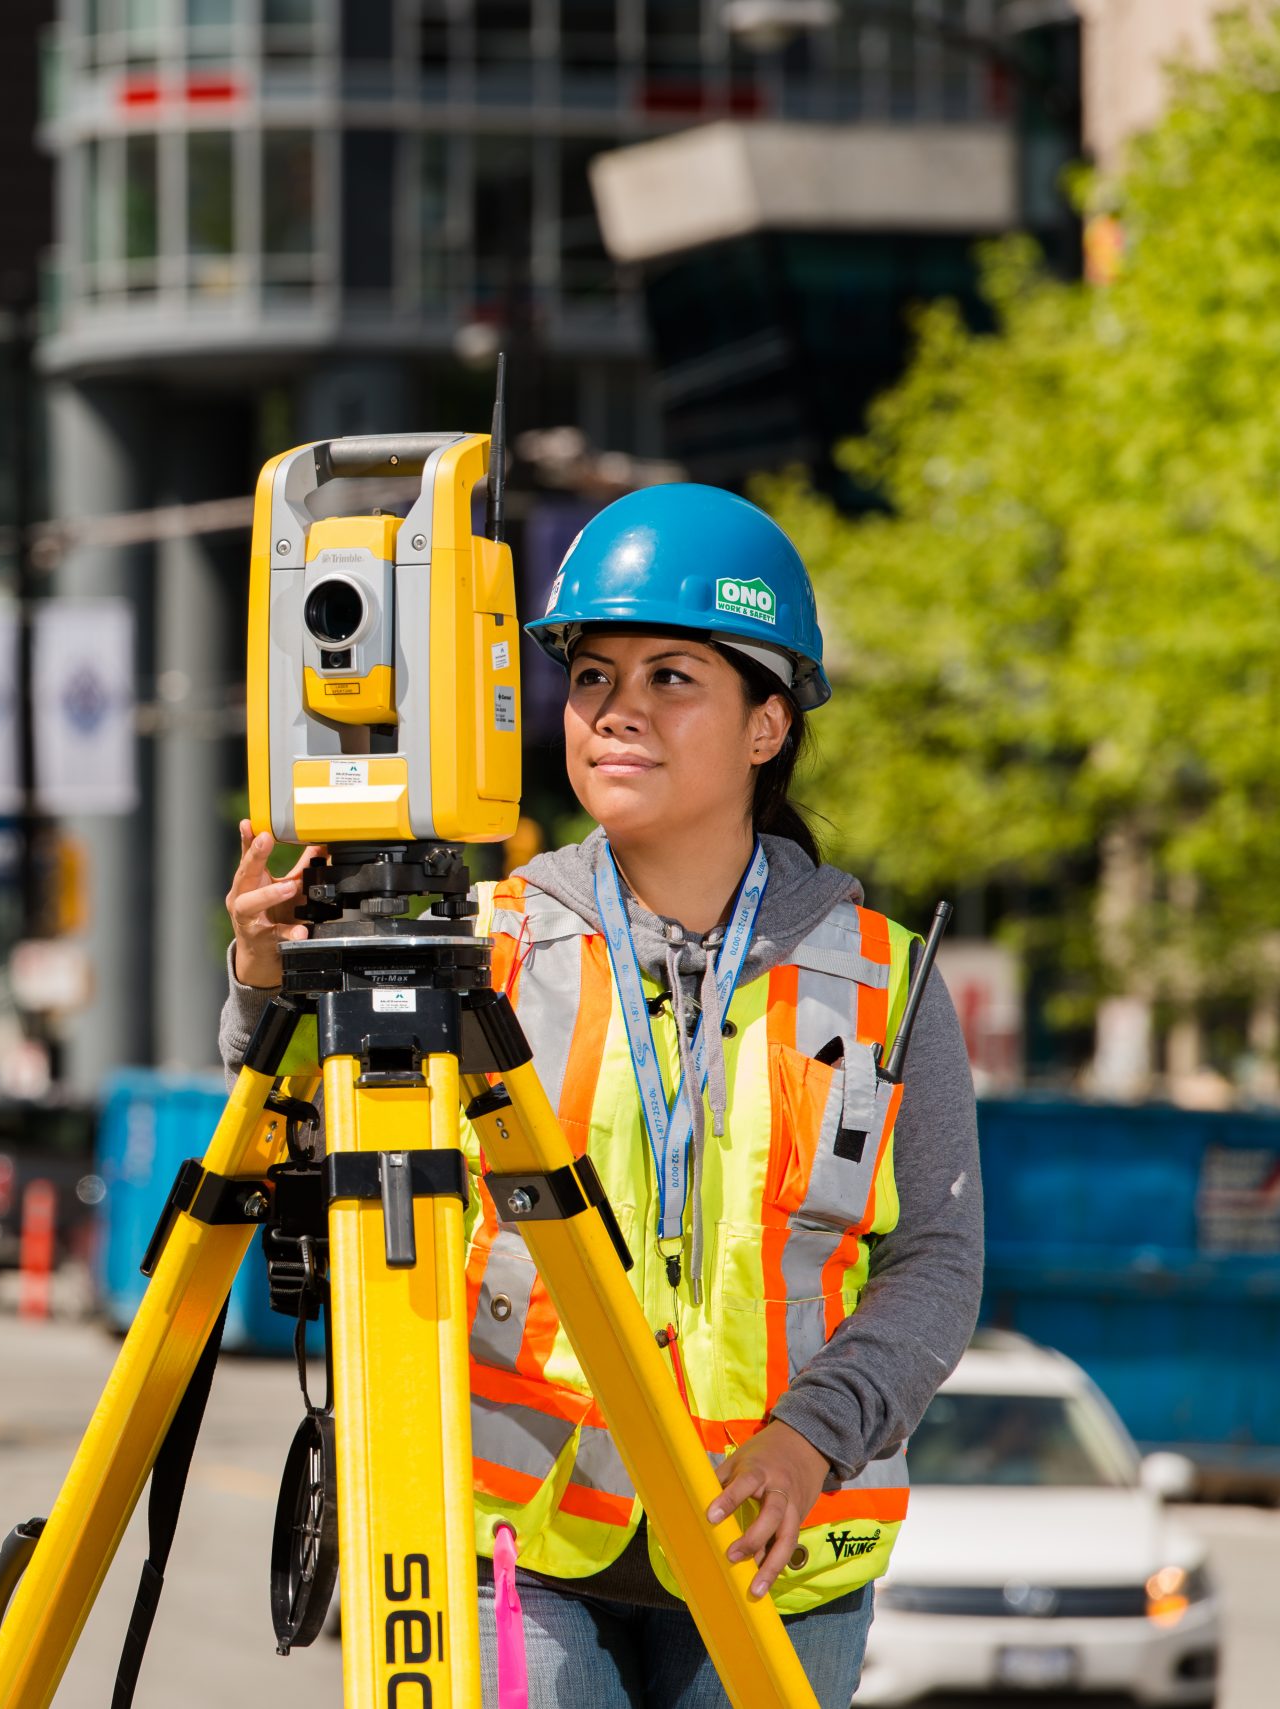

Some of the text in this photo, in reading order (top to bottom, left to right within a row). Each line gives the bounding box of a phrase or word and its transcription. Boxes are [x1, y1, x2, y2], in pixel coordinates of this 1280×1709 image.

[331, 553, 363, 563] Trimble
[721, 582, 772, 611] ONO
[718, 601, 741, 613] WORK
[749, 610, 775, 623] SAFETY
